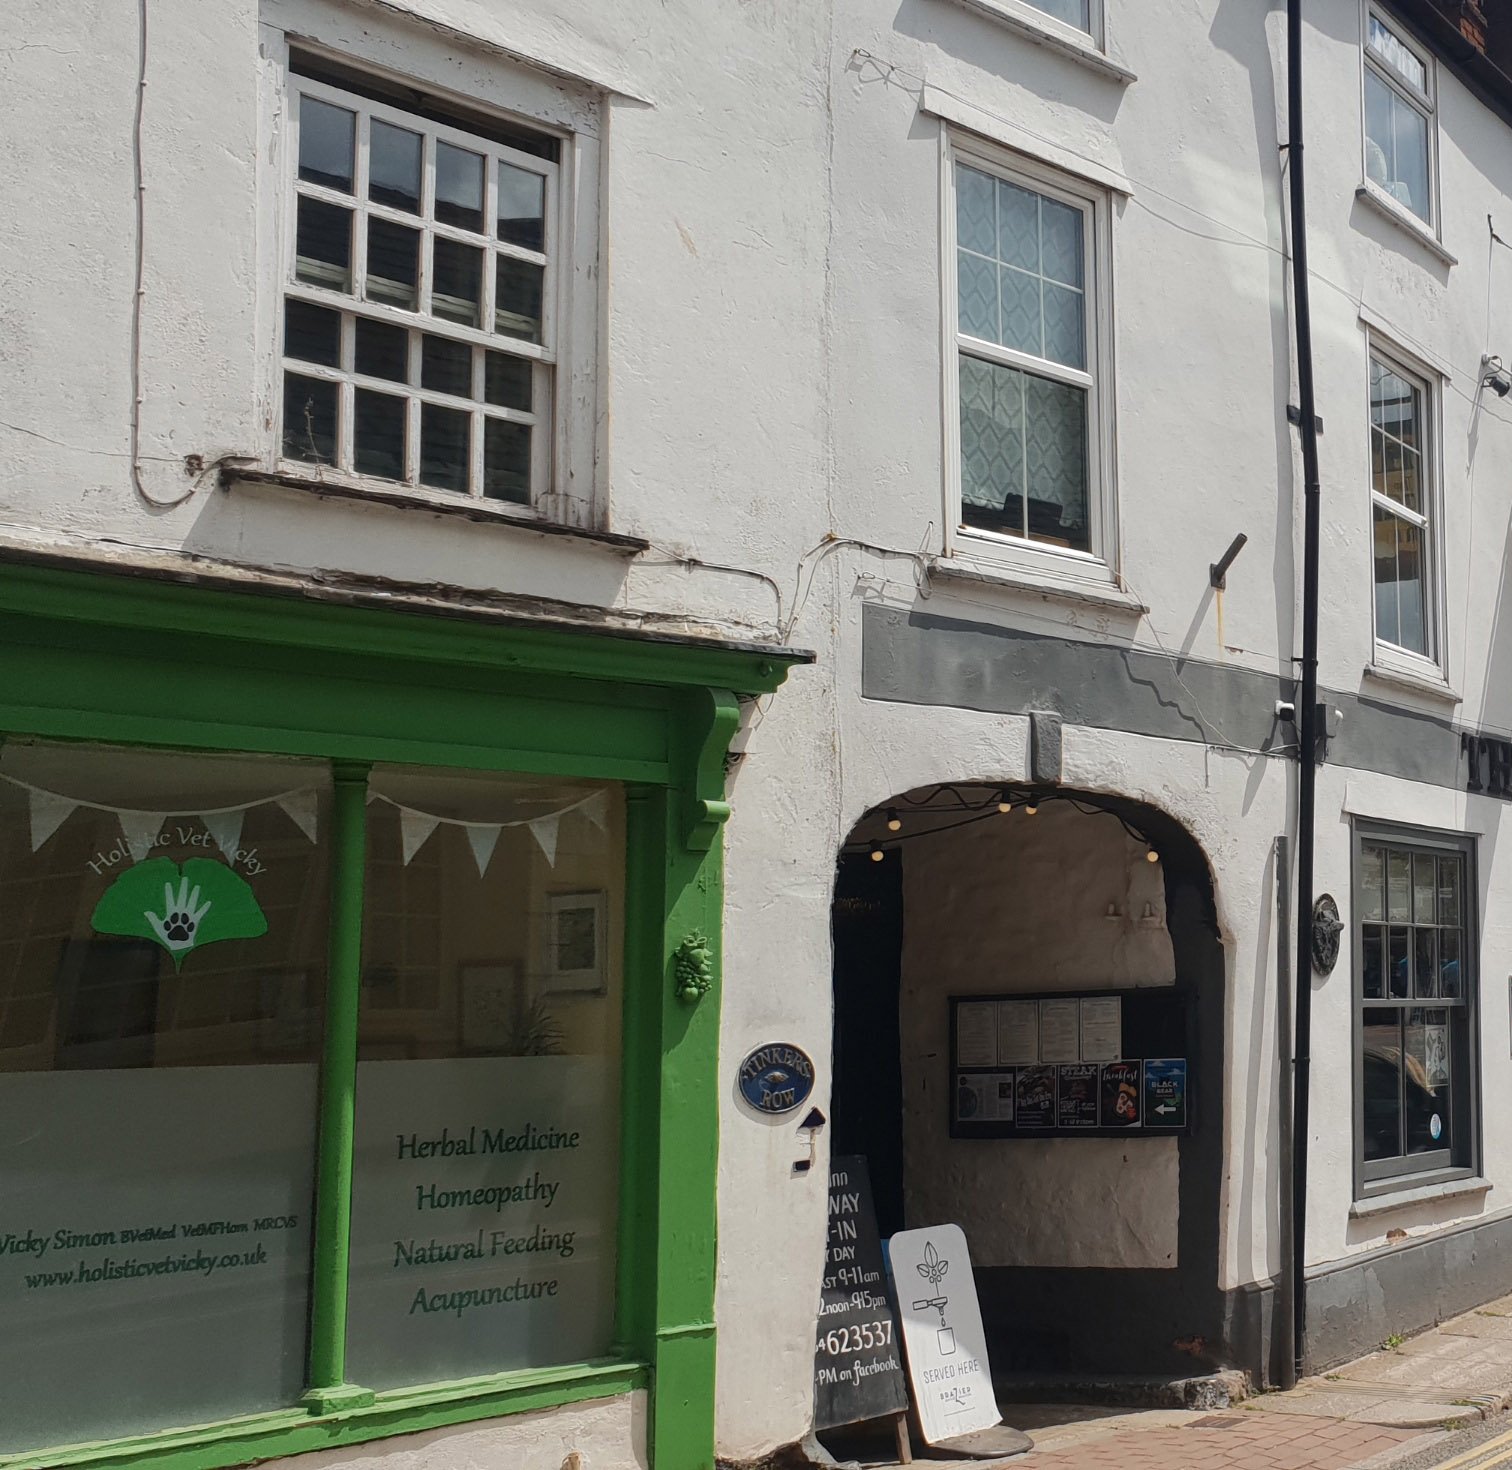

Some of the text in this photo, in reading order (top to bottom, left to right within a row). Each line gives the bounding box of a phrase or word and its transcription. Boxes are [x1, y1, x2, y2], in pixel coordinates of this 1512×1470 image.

[176, 826, 211, 848] Vet
[741, 1047, 811, 1078] TINKERS
[1060, 1065, 1097, 1076] STEAK
[759, 1087, 795, 1109] ROW
[396, 1122, 580, 1159] Herbal Medicine
[415, 1172, 560, 1213] Homeopathy
[0, 1229, 50, 1258] Vicky
[53, 1229, 117, 1250] Simon
[252, 1215, 298, 1232] MRCVS
[394, 1224, 576, 1267] Natural Feeding
[24, 1242, 267, 1288] www.holisticvetvicky.co.uk
[833, 1245, 856, 1263] DAY
[838, 1265, 880, 1286] 9-11am
[408, 1276, 559, 1318] Acupuncture
[826, 1319, 893, 1355] 623537
[839, 1369, 852, 1381] on
[852, 1354, 900, 1387] facebook
[923, 1359, 979, 1384] SERVED HERE
[939, 1385, 972, 1405] BRAZIER
